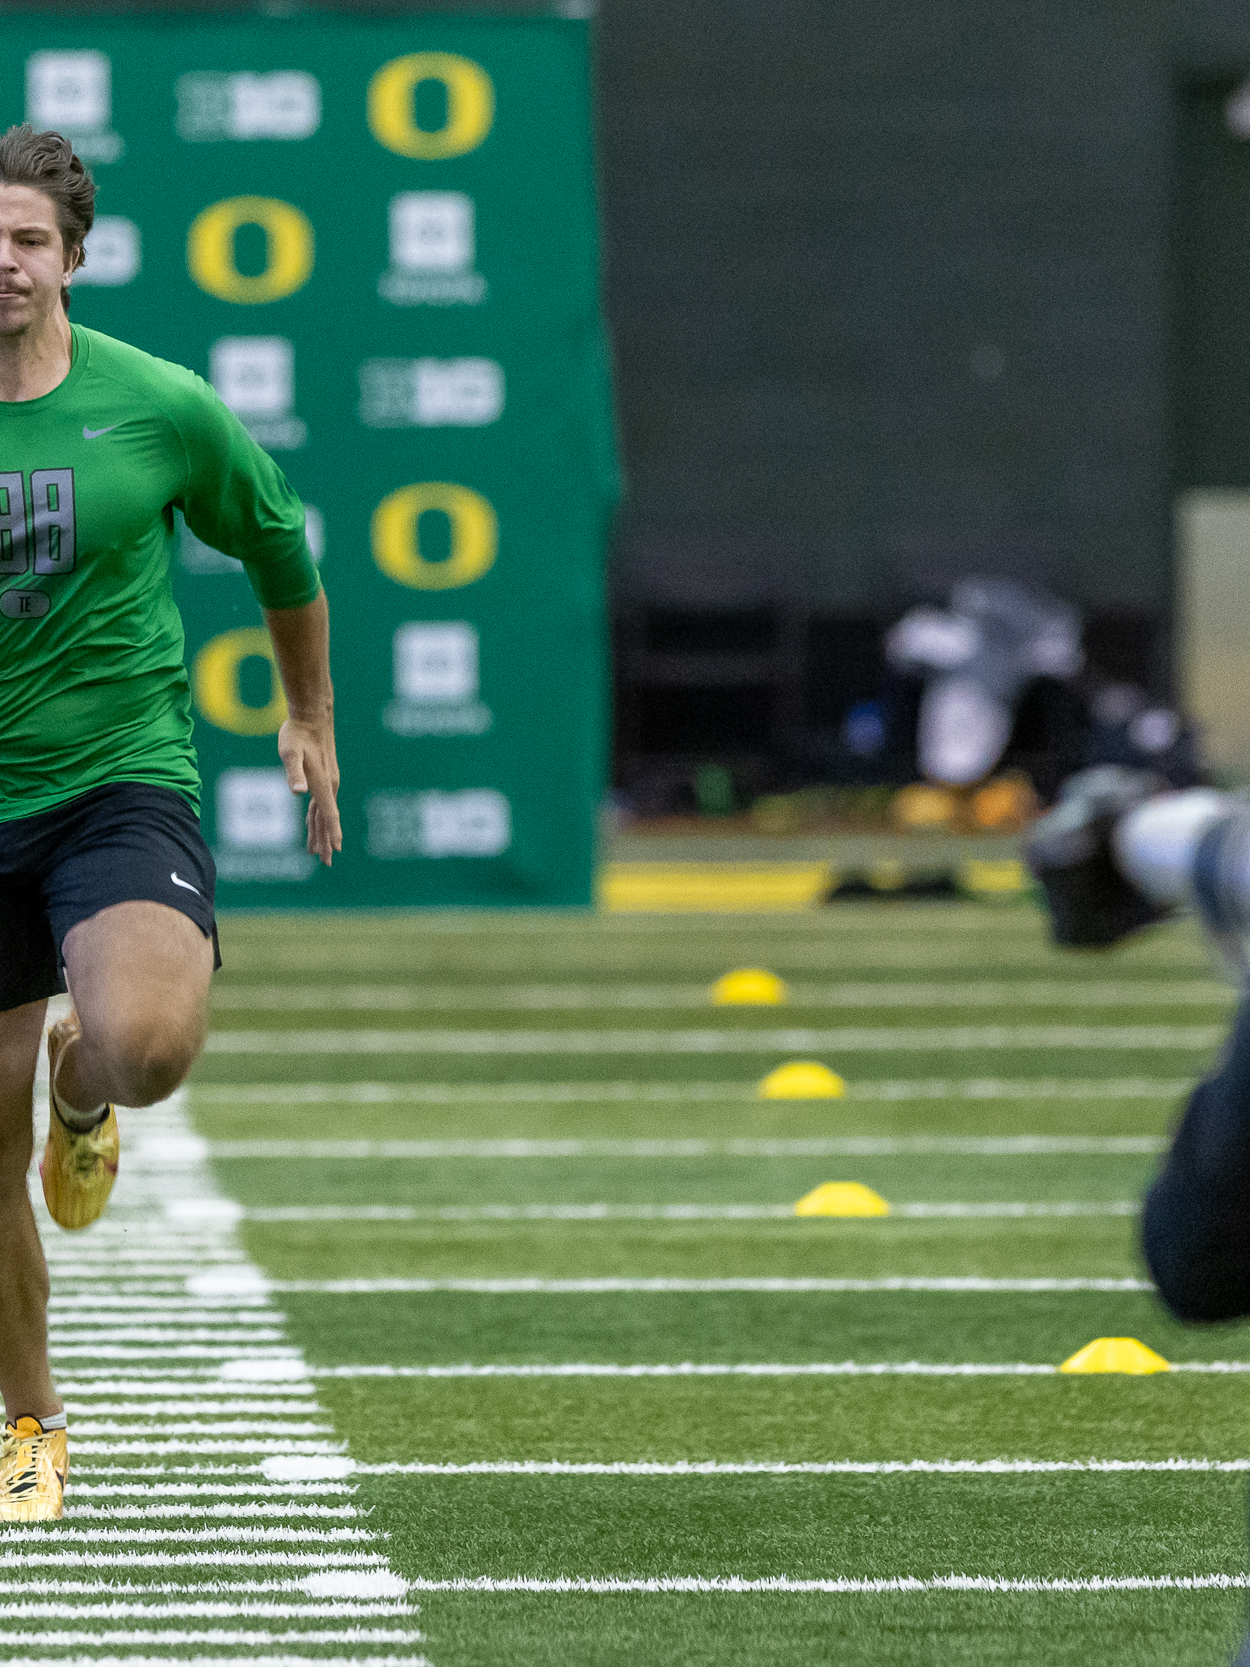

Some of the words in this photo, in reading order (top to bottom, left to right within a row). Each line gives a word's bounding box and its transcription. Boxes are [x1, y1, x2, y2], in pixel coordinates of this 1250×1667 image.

[369, 53, 493, 159] O
[188, 196, 313, 302] O
[372, 483, 497, 589] O
[18, 596, 31, 612] TE
[192, 626, 289, 736] O
